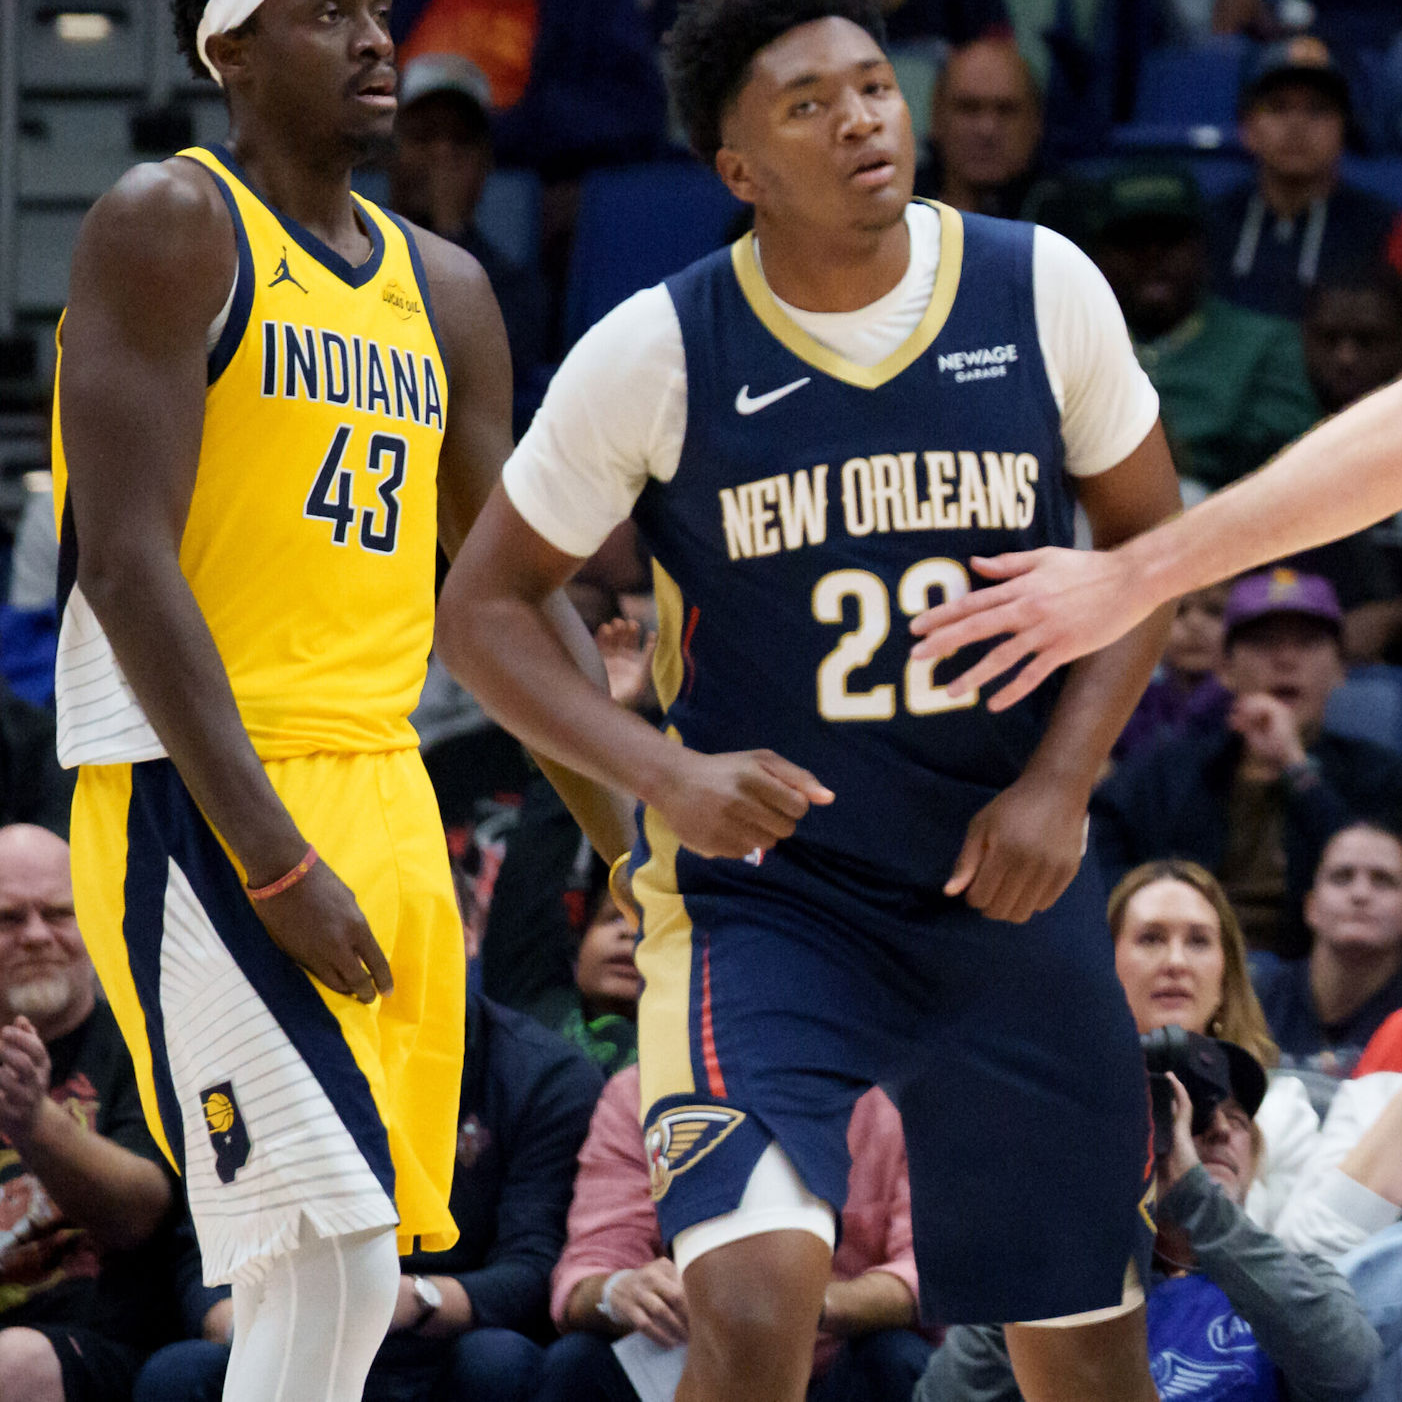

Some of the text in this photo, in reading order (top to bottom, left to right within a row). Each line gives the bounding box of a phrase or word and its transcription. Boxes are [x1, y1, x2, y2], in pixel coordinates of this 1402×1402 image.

[382, 289, 421, 314] LUCAS OIL
[261, 319, 445, 434] INDIANA
[937, 343, 1018, 374] NEWAGE
[954, 364, 1008, 384] GARAGE
[303, 422, 410, 557] 43
[719, 450, 1040, 562] NEW ORLEANS
[810, 556, 981, 722] 22
